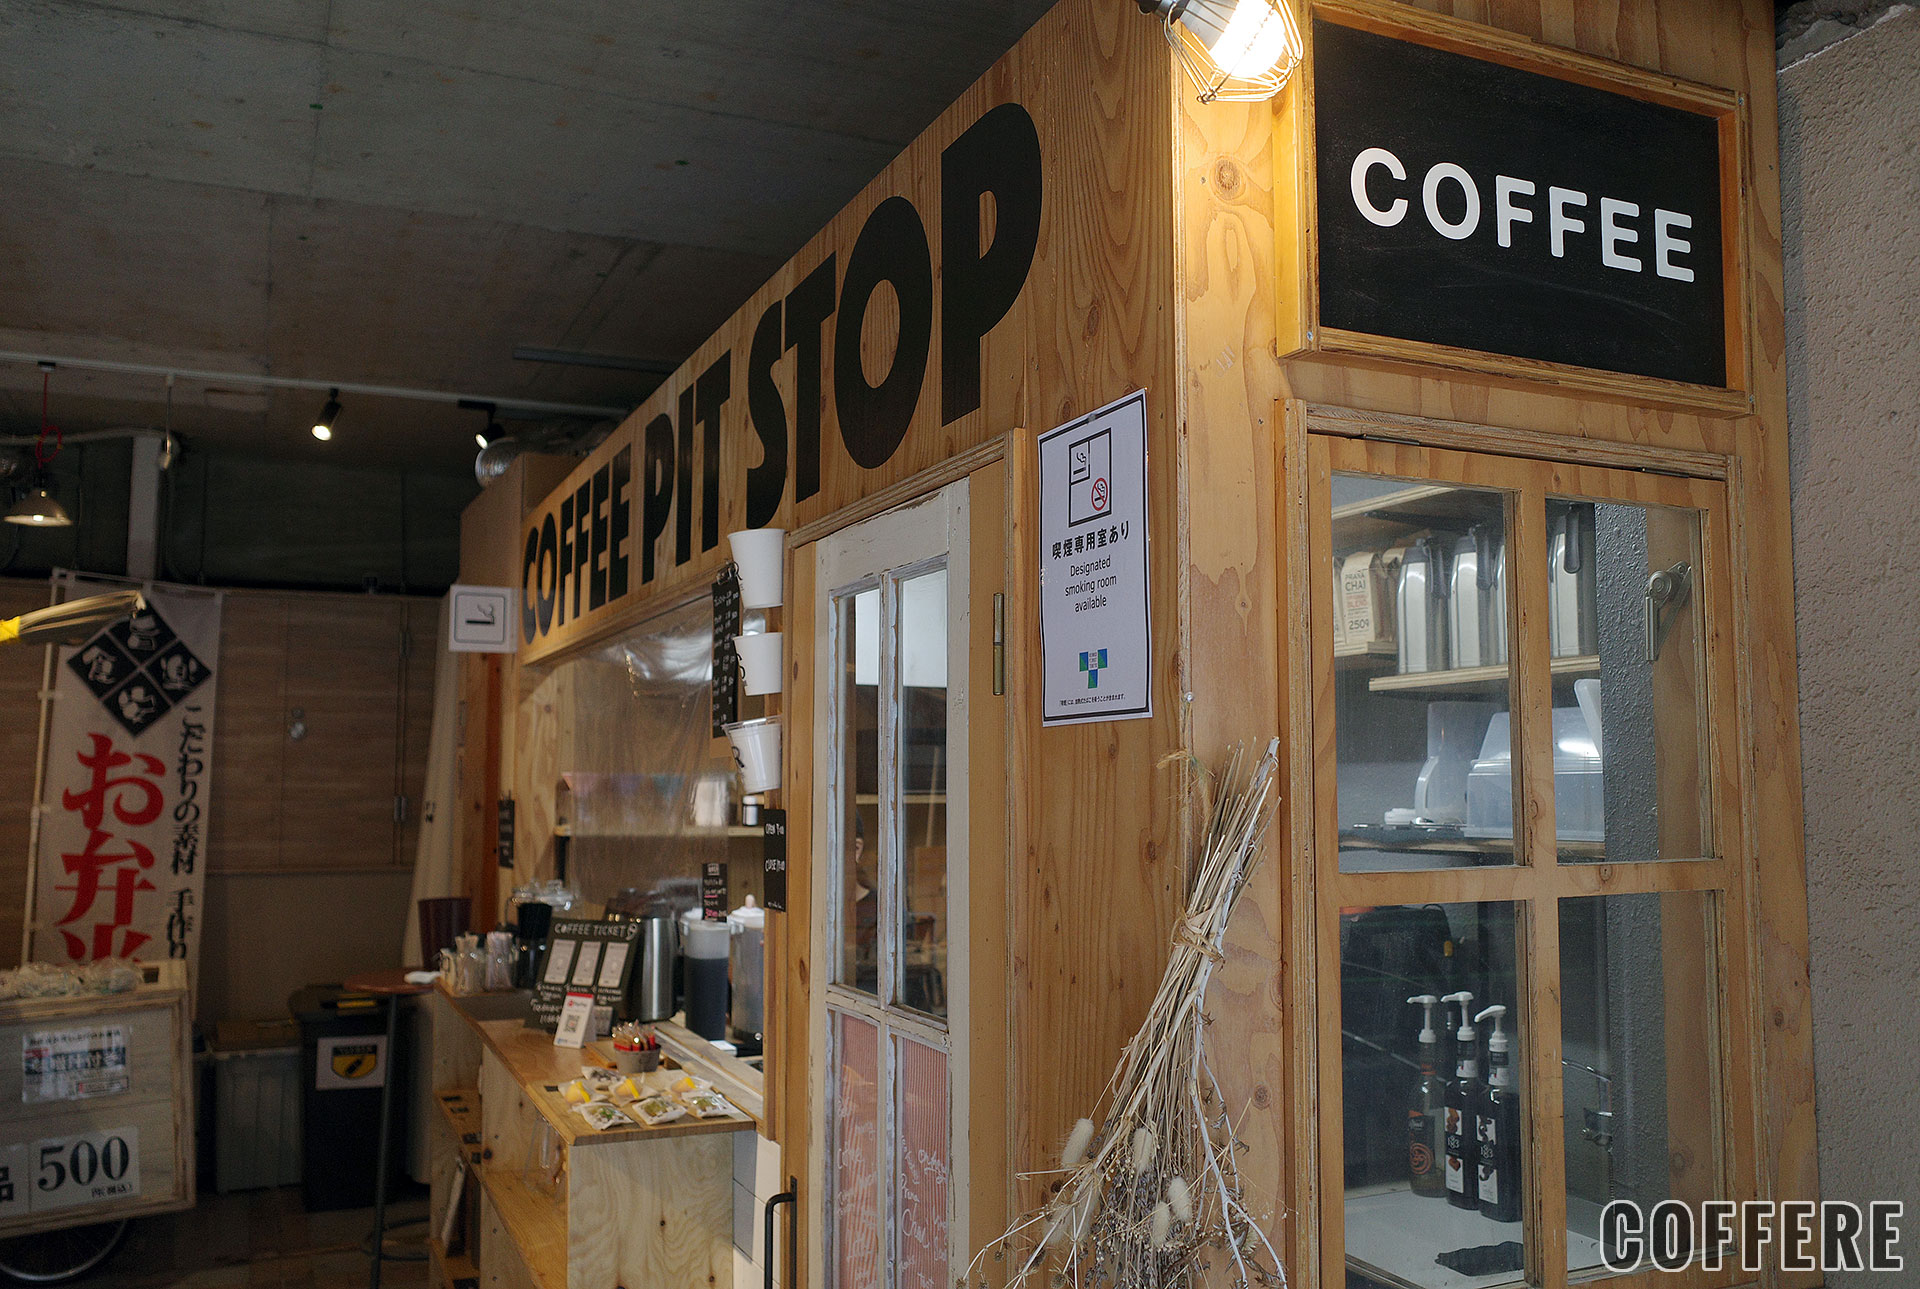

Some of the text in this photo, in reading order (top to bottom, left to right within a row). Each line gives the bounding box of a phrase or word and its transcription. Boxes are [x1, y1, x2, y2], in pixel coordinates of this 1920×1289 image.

[1350, 147, 1695, 283] COFFEE
[522, 102, 1042, 645] COFFEE PIT STOP
[1052, 520, 1129, 560] 喫煙専用室あり
[1070, 555, 1111, 577] Designated
[1065, 575, 1117, 597] smoking room
[1346, 582, 1366, 591] CHAI
[1074, 595, 1107, 613] available
[554, 922, 591, 936] COFFEE
[37, 1136, 130, 1192] 500
